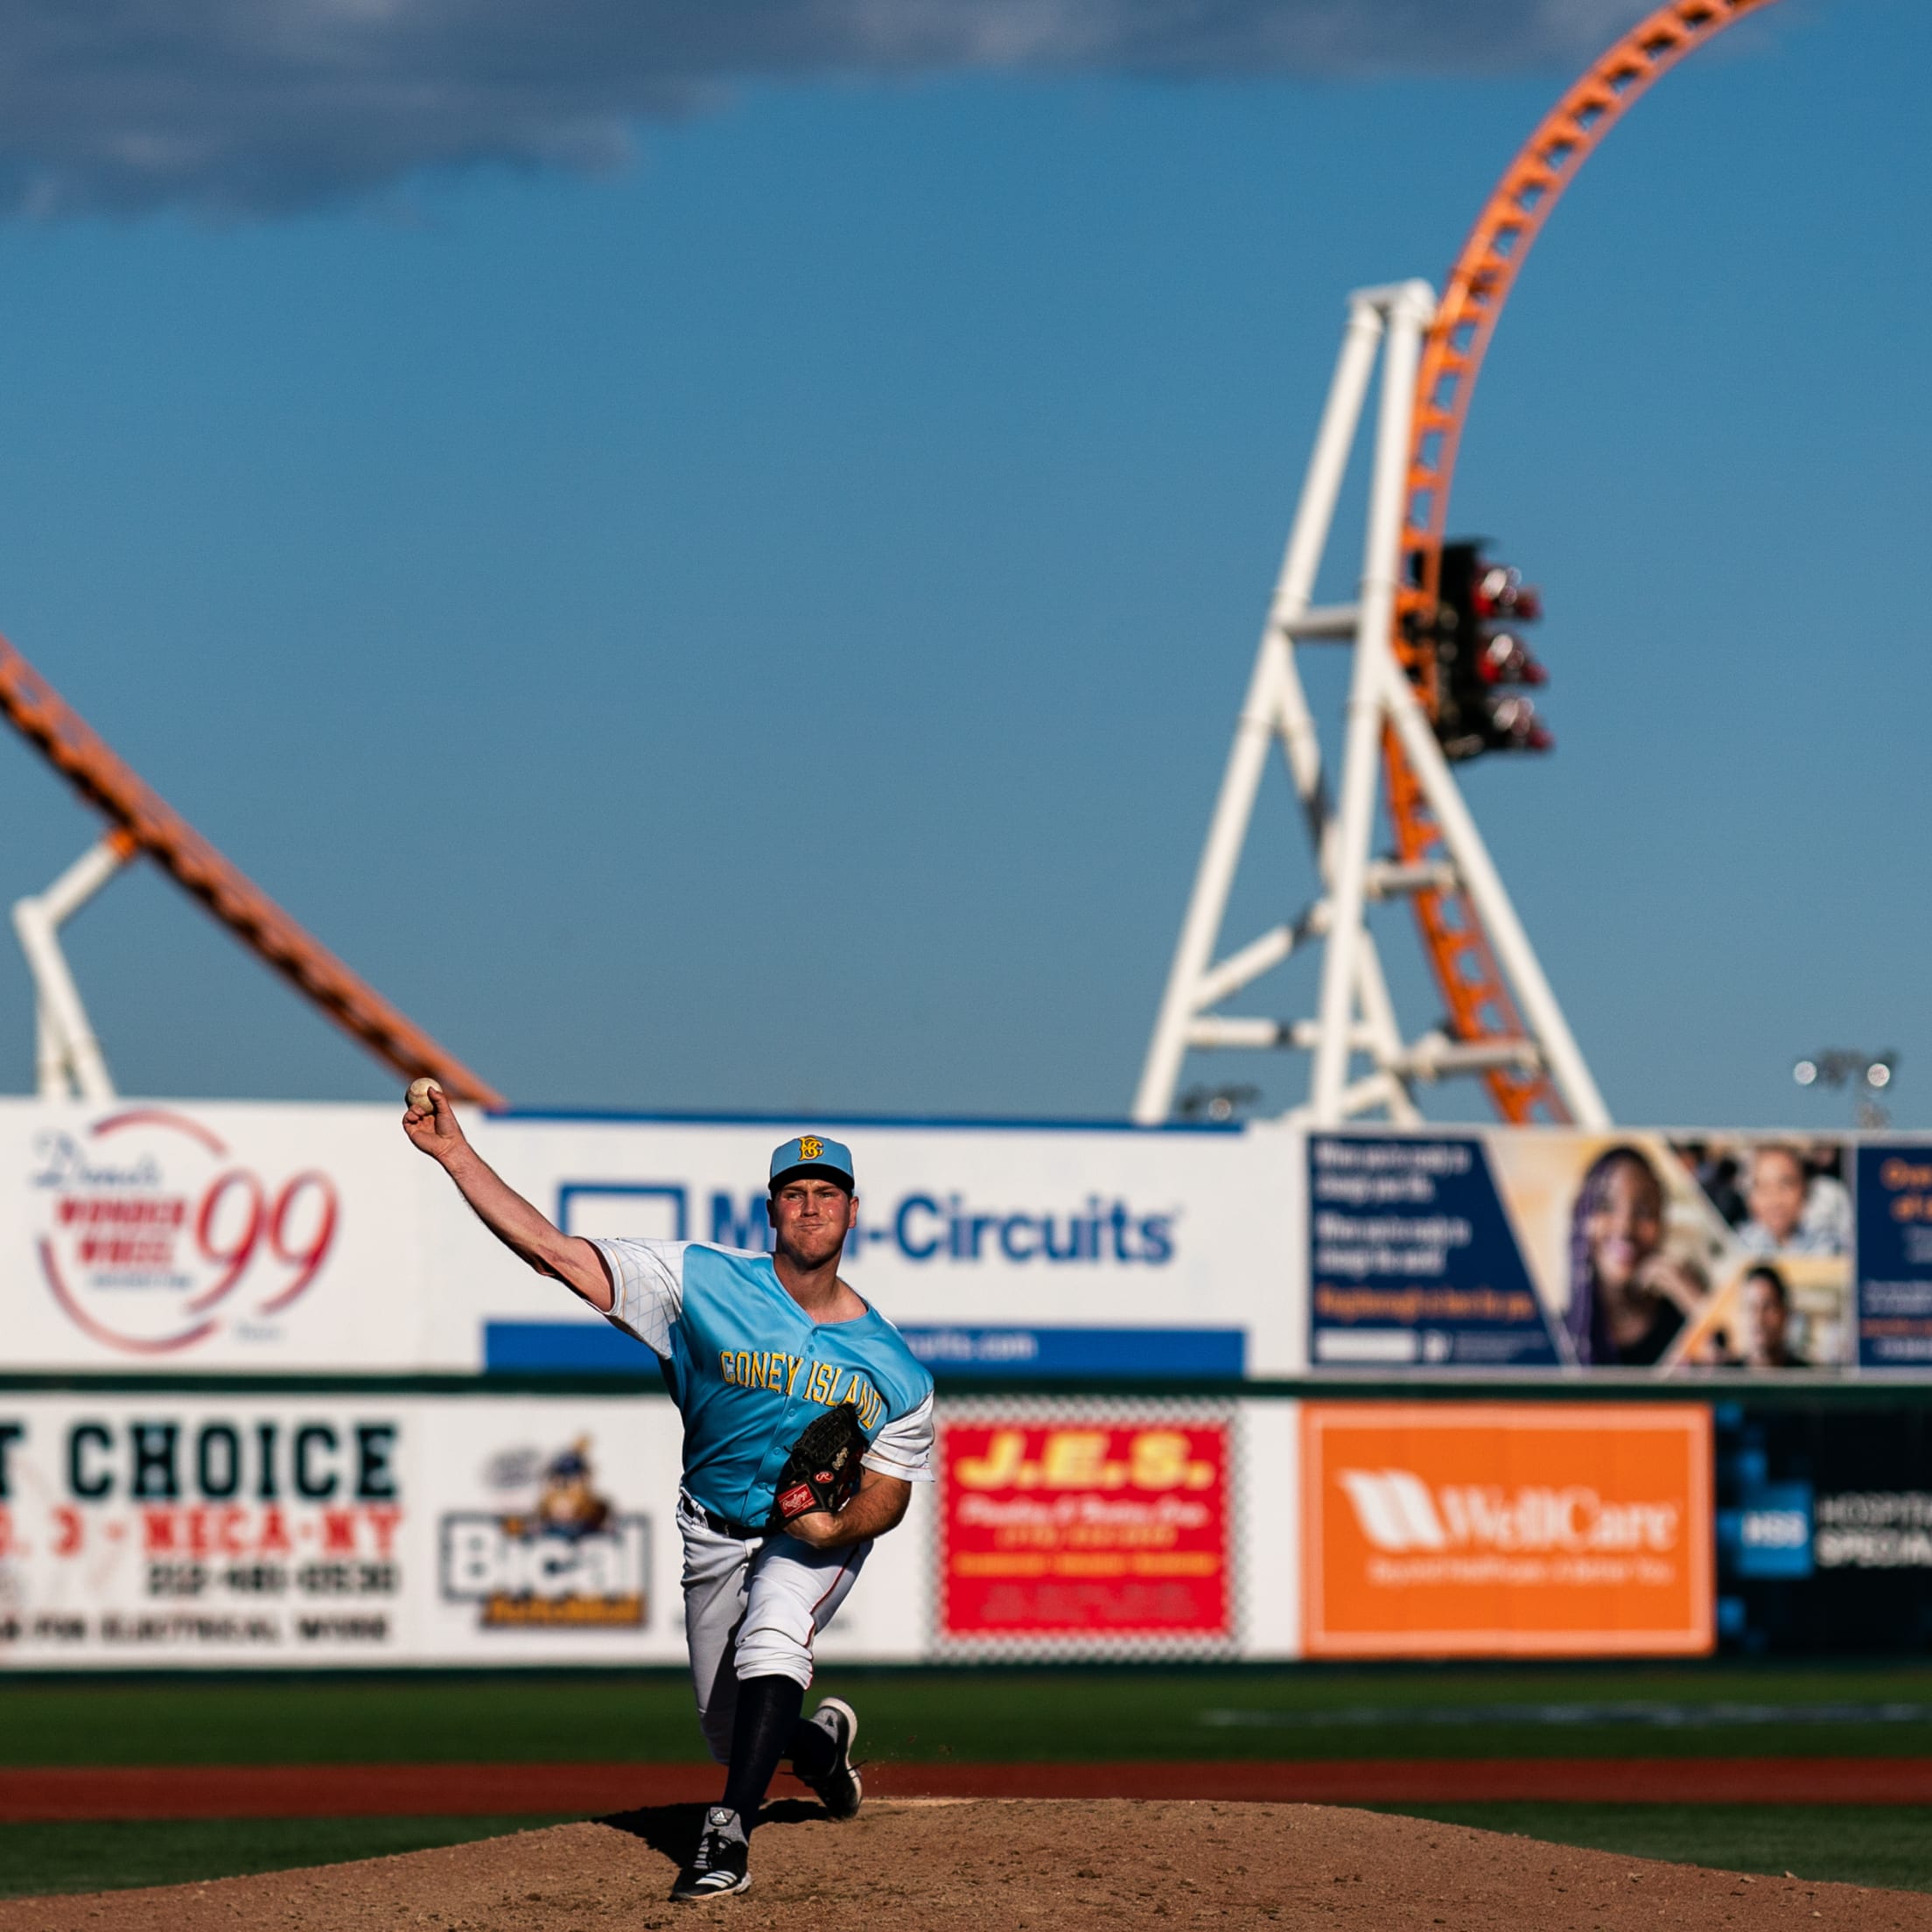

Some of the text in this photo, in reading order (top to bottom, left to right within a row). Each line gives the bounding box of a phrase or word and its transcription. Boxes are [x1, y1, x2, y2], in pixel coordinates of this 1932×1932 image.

[186, 1167, 340, 1314] 99
[720, 1351, 883, 1430] CONEY ISLAND
[69, 1421, 399, 1501] CHOICE
[956, 1432, 1215, 1489] J.E.S.
[1443, 1490, 1676, 1548] WellCare
[1818, 1531, 1932, 1563] SPECIA
[450, 1521, 641, 1596] Bical
